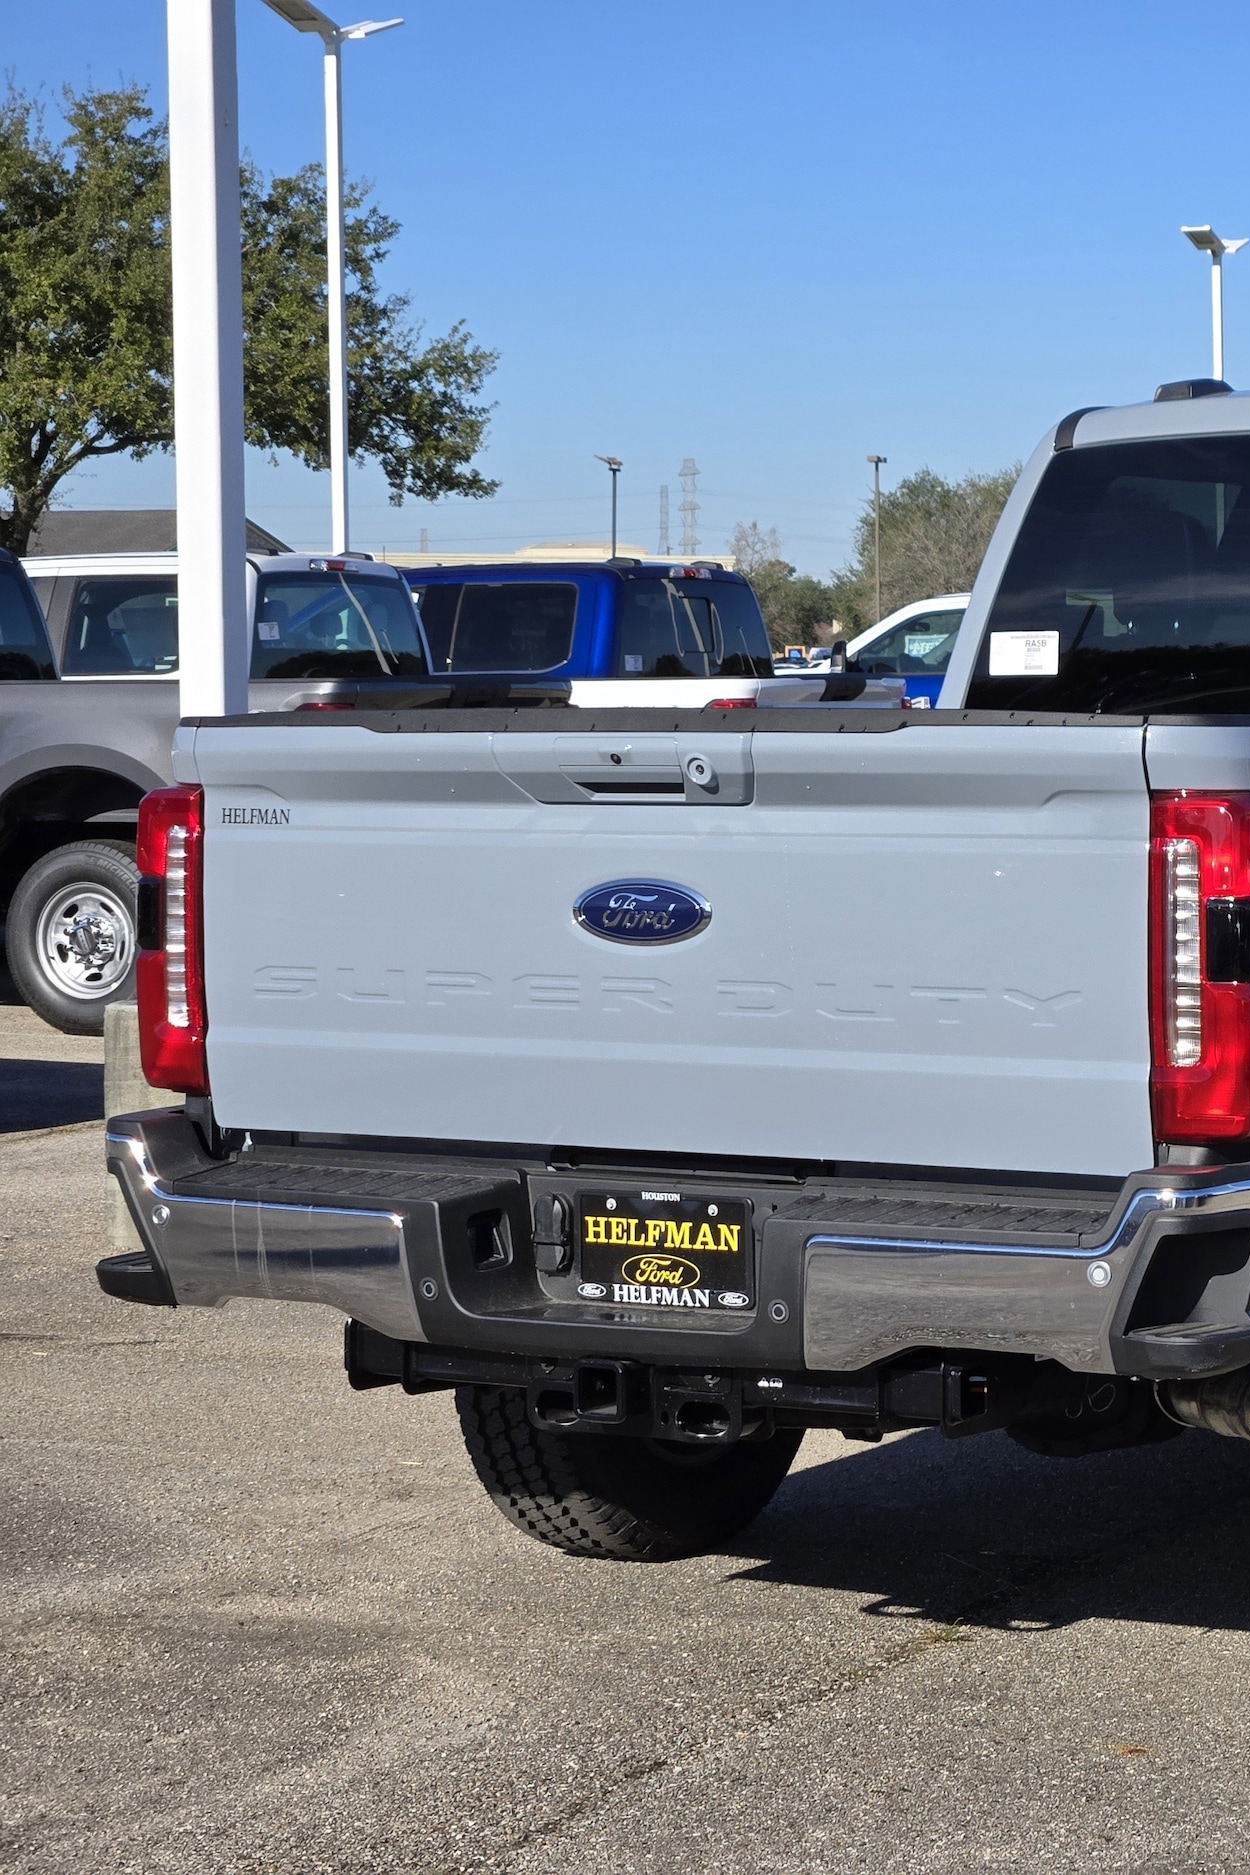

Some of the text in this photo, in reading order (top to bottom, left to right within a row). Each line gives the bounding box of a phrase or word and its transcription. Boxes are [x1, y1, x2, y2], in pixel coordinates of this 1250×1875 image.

[221, 807, 291, 825] HELFMAN
[97, 858, 137, 893] MICHELI
[602, 892, 676, 930] Ford
[254, 965, 1082, 1028] SUPER DUTY
[641, 1191, 681, 1202] HOUSTON
[584, 1216, 741, 1252] HELFMAN
[635, 1257, 684, 1285] Ford
[612, 1283, 711, 1308] HELFMAN
